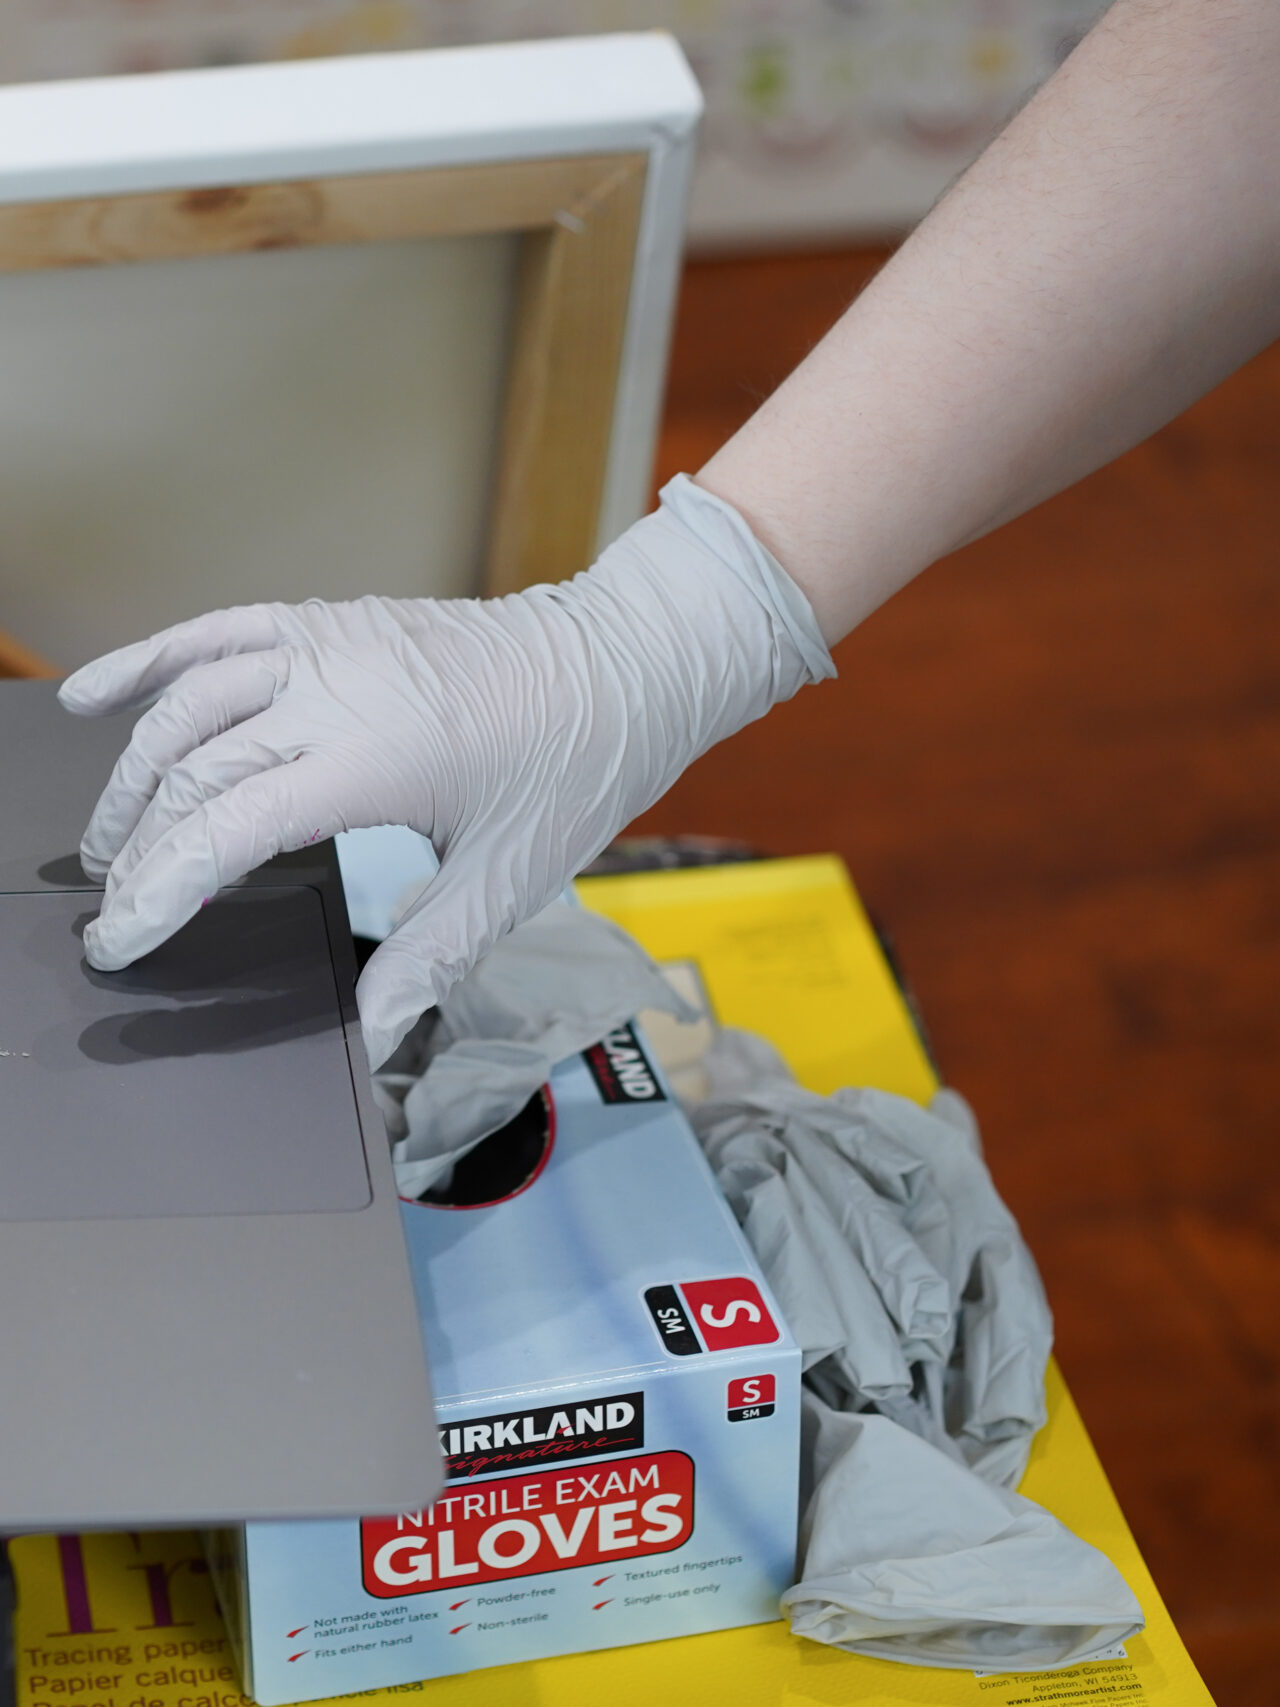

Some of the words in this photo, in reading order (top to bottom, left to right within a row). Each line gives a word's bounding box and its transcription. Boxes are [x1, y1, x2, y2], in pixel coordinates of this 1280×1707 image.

[657, 1307, 686, 1334] SM
[700, 1299, 761, 1328] S
[742, 1379, 761, 1403] S
[742, 1409, 760, 1419] SM
[396, 1483, 543, 1530] NITRILE
[555, 1464, 660, 1505] EXAM
[373, 1493, 684, 1586] GLOVES
[624, 1563, 680, 1582] Textured
[682, 1554, 743, 1573] fingertips
[477, 1586, 557, 1607] Powder-free
[623, 1590, 690, 1607] Single-use
[693, 1583, 721, 1597] only
[314, 1617, 337, 1628] Not
[341, 1610, 377, 1624] made
[380, 1605, 408, 1617] with
[314, 1623, 358, 1638] natural
[362, 1617, 405, 1631] rubber
[408, 1611, 439, 1623] latex
[477, 1611, 549, 1631] Non-sterile
[25, 1643, 133, 1667] Tracing
[143, 1637, 227, 1661] paper
[315, 1649, 337, 1659] Fits
[340, 1641, 377, 1655] either
[381, 1635, 413, 1647] hand
[29, 1671, 123, 1695] Papier
[135, 1665, 234, 1687] calque
[979, 1679, 1009, 1691] Dixon
[1013, 1669, 1080, 1684] Ticonderoga
[1082, 1663, 1134, 1677] Company
[1032, 1682, 1083, 1694] Appleton,
[1084, 1678, 1098, 1686] WI
[1103, 1674, 1138, 1685] 54913
[1006, 1683, 1142, 1706] www.strathmoreartist.com
